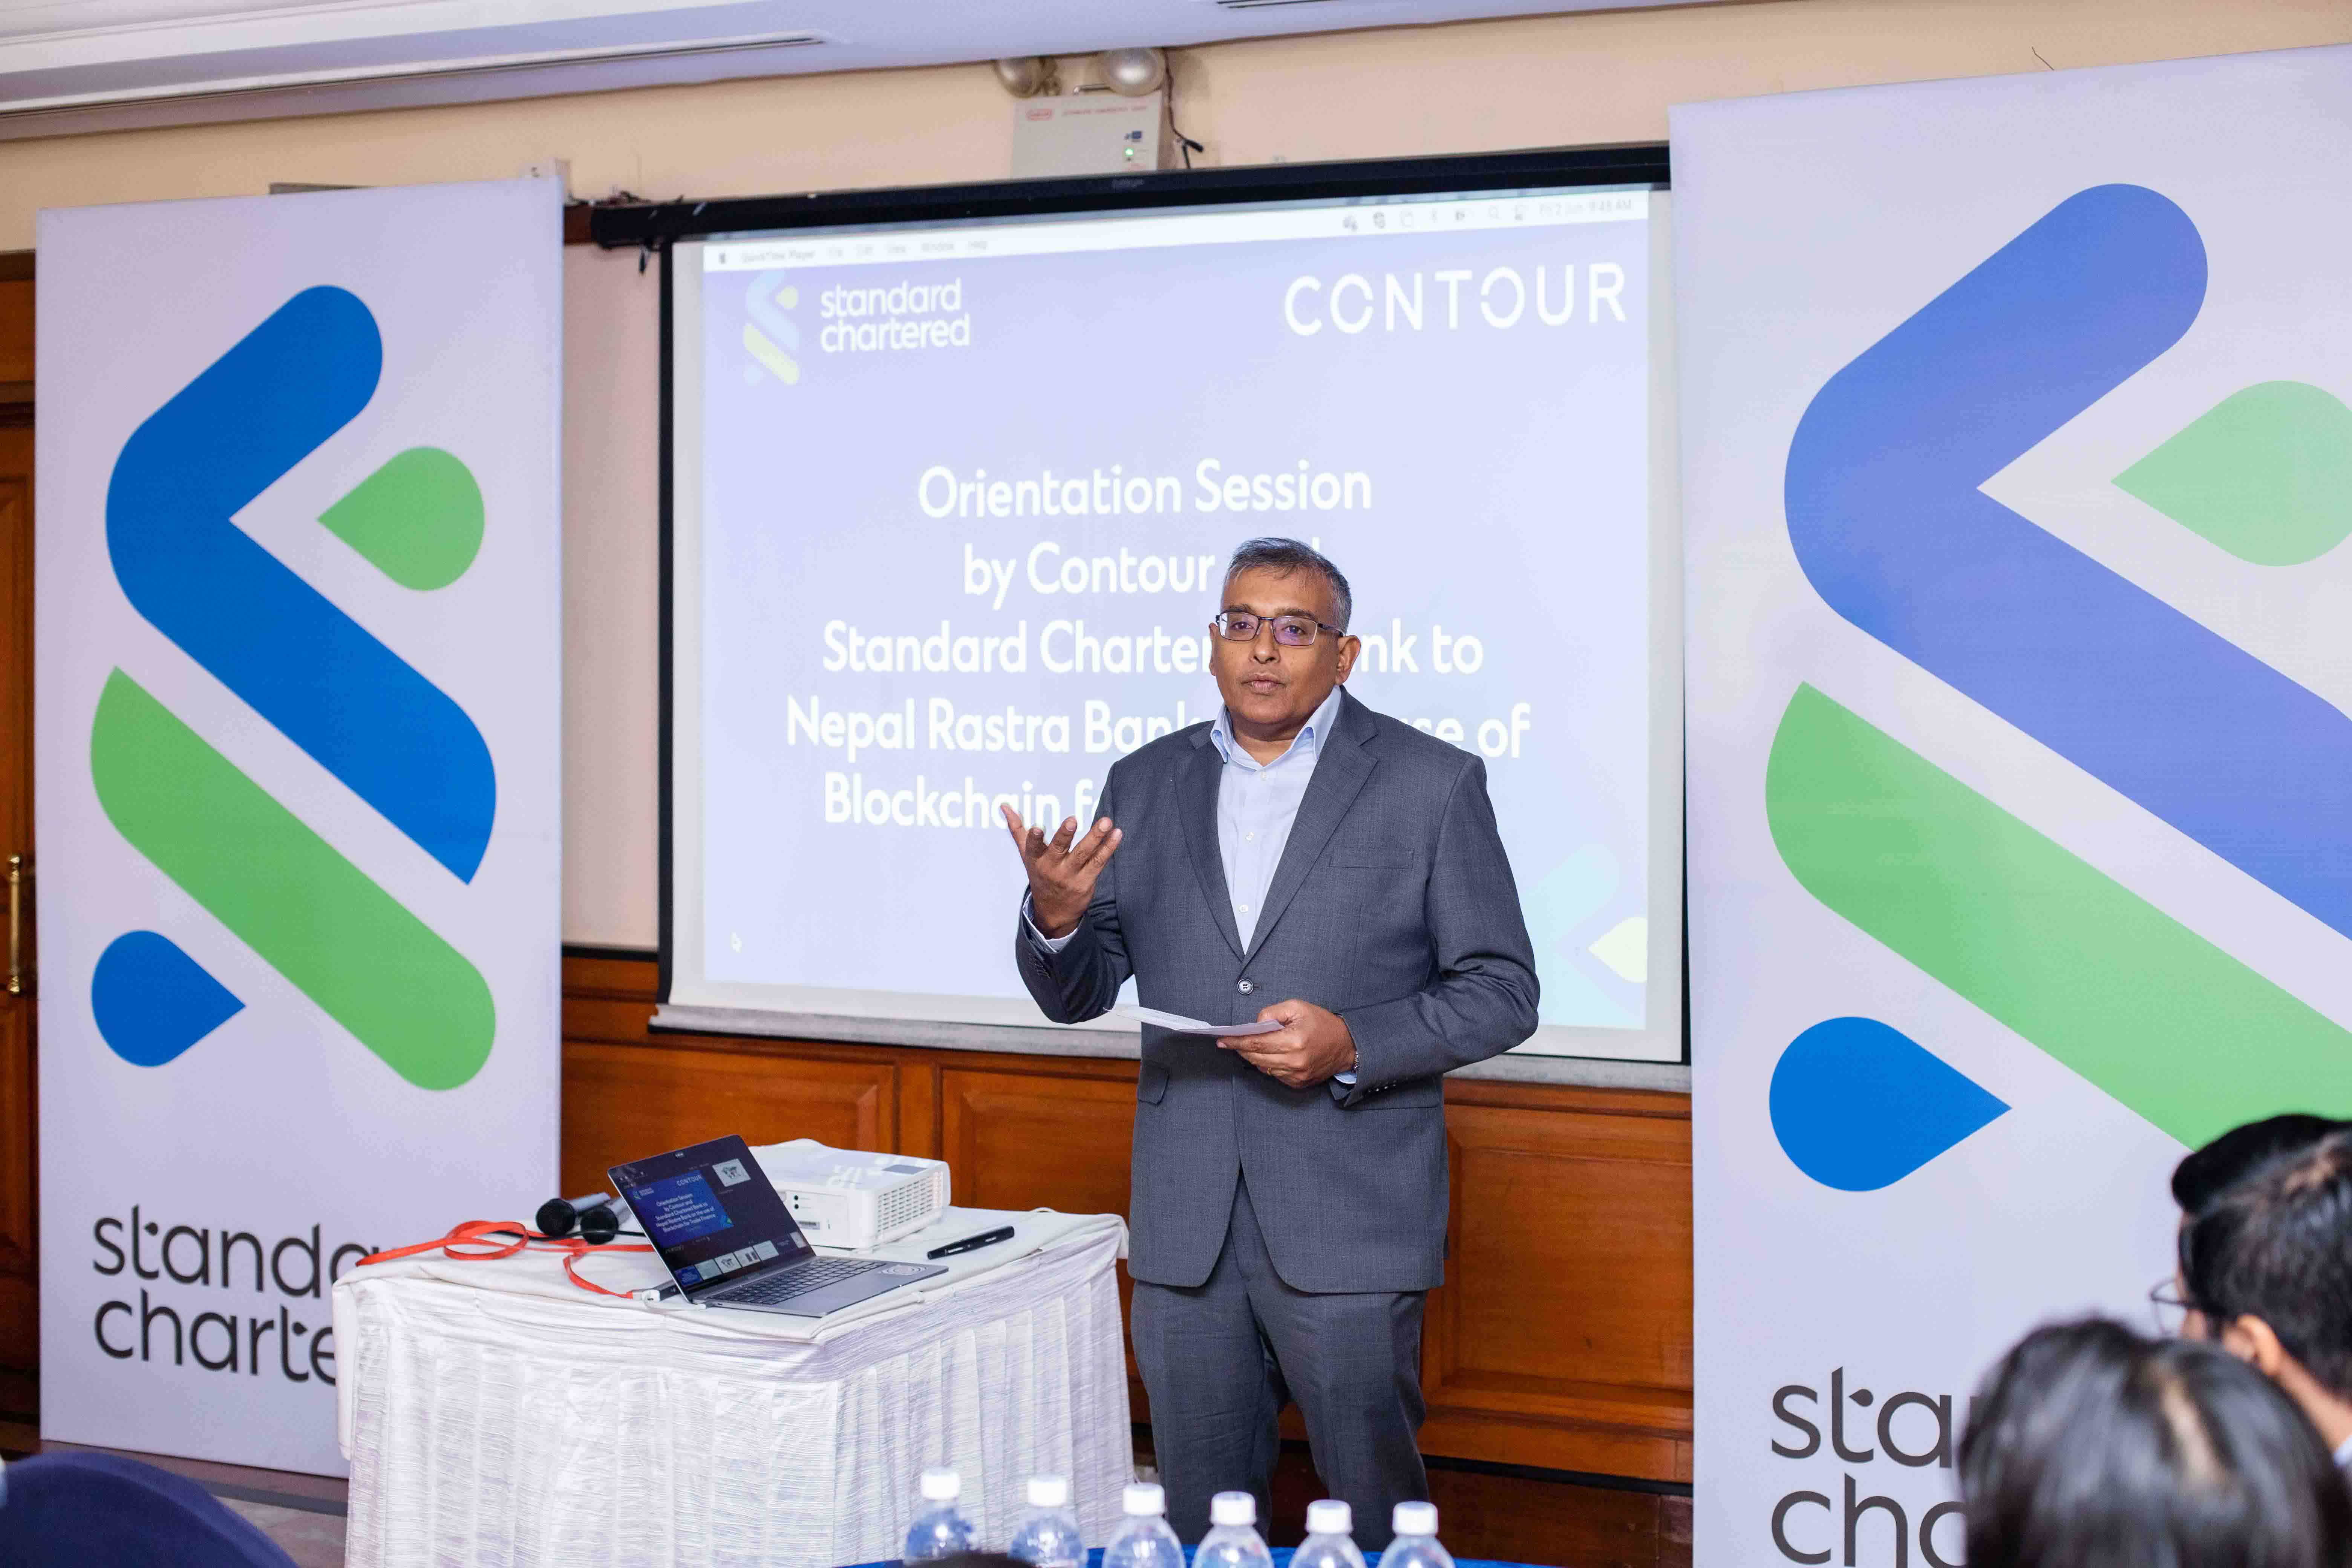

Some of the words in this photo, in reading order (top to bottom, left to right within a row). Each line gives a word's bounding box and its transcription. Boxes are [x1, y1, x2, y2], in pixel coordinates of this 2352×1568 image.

[820, 277, 962, 317] standard
[1284, 262, 1627, 336] CONTOUR
[820, 312, 971, 353] chartered
[918, 464, 1182, 518] Orientation
[1195, 458, 1371, 512] Session
[964, 541, 1018, 611] by
[1026, 541, 1216, 595] Contour
[822, 619, 1027, 674] Standard
[1039, 619, 1211, 674] Charter
[1432, 624, 1484, 675] to
[787, 694, 916, 764] Nepal
[927, 697, 1070, 753] Rastra
[1476, 701, 1531, 759] of
[824, 770, 1061, 833] Blockchain
[93, 1204, 379, 1298] stand
[94, 1288, 336, 1386] charte
